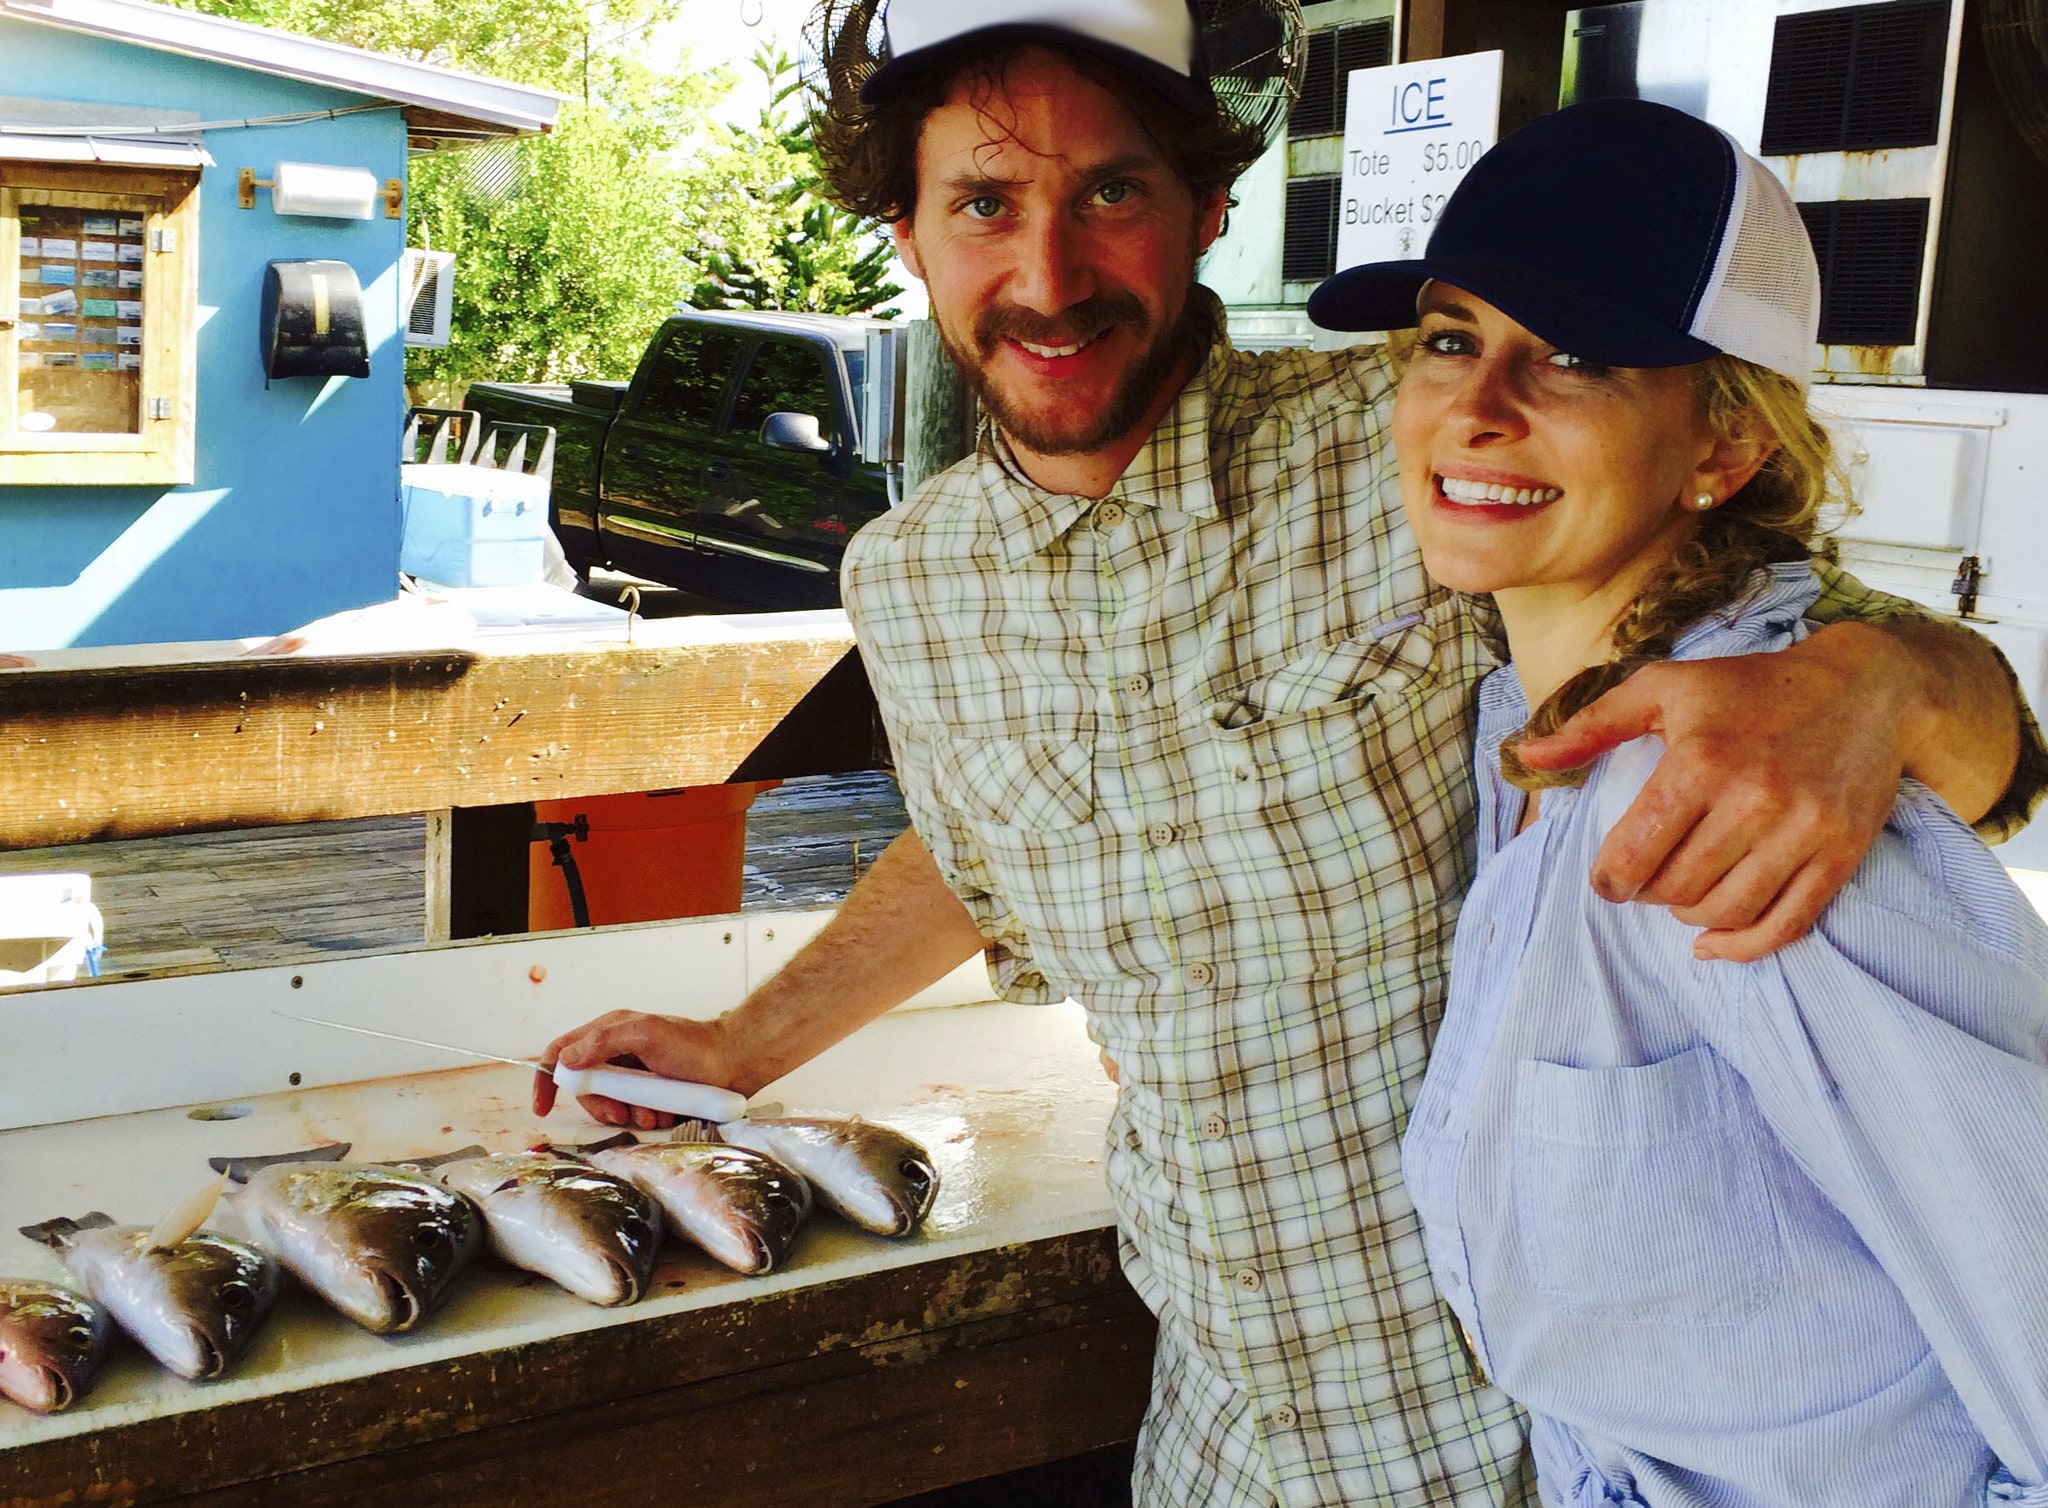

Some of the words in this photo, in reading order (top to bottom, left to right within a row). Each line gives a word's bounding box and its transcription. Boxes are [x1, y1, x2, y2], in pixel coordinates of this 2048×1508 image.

[1392, 78, 1446, 126] ICE
[1349, 150, 1390, 177] Tote
[1422, 140, 1482, 174] $5.00
[1345, 196, 1414, 225] Bucket
